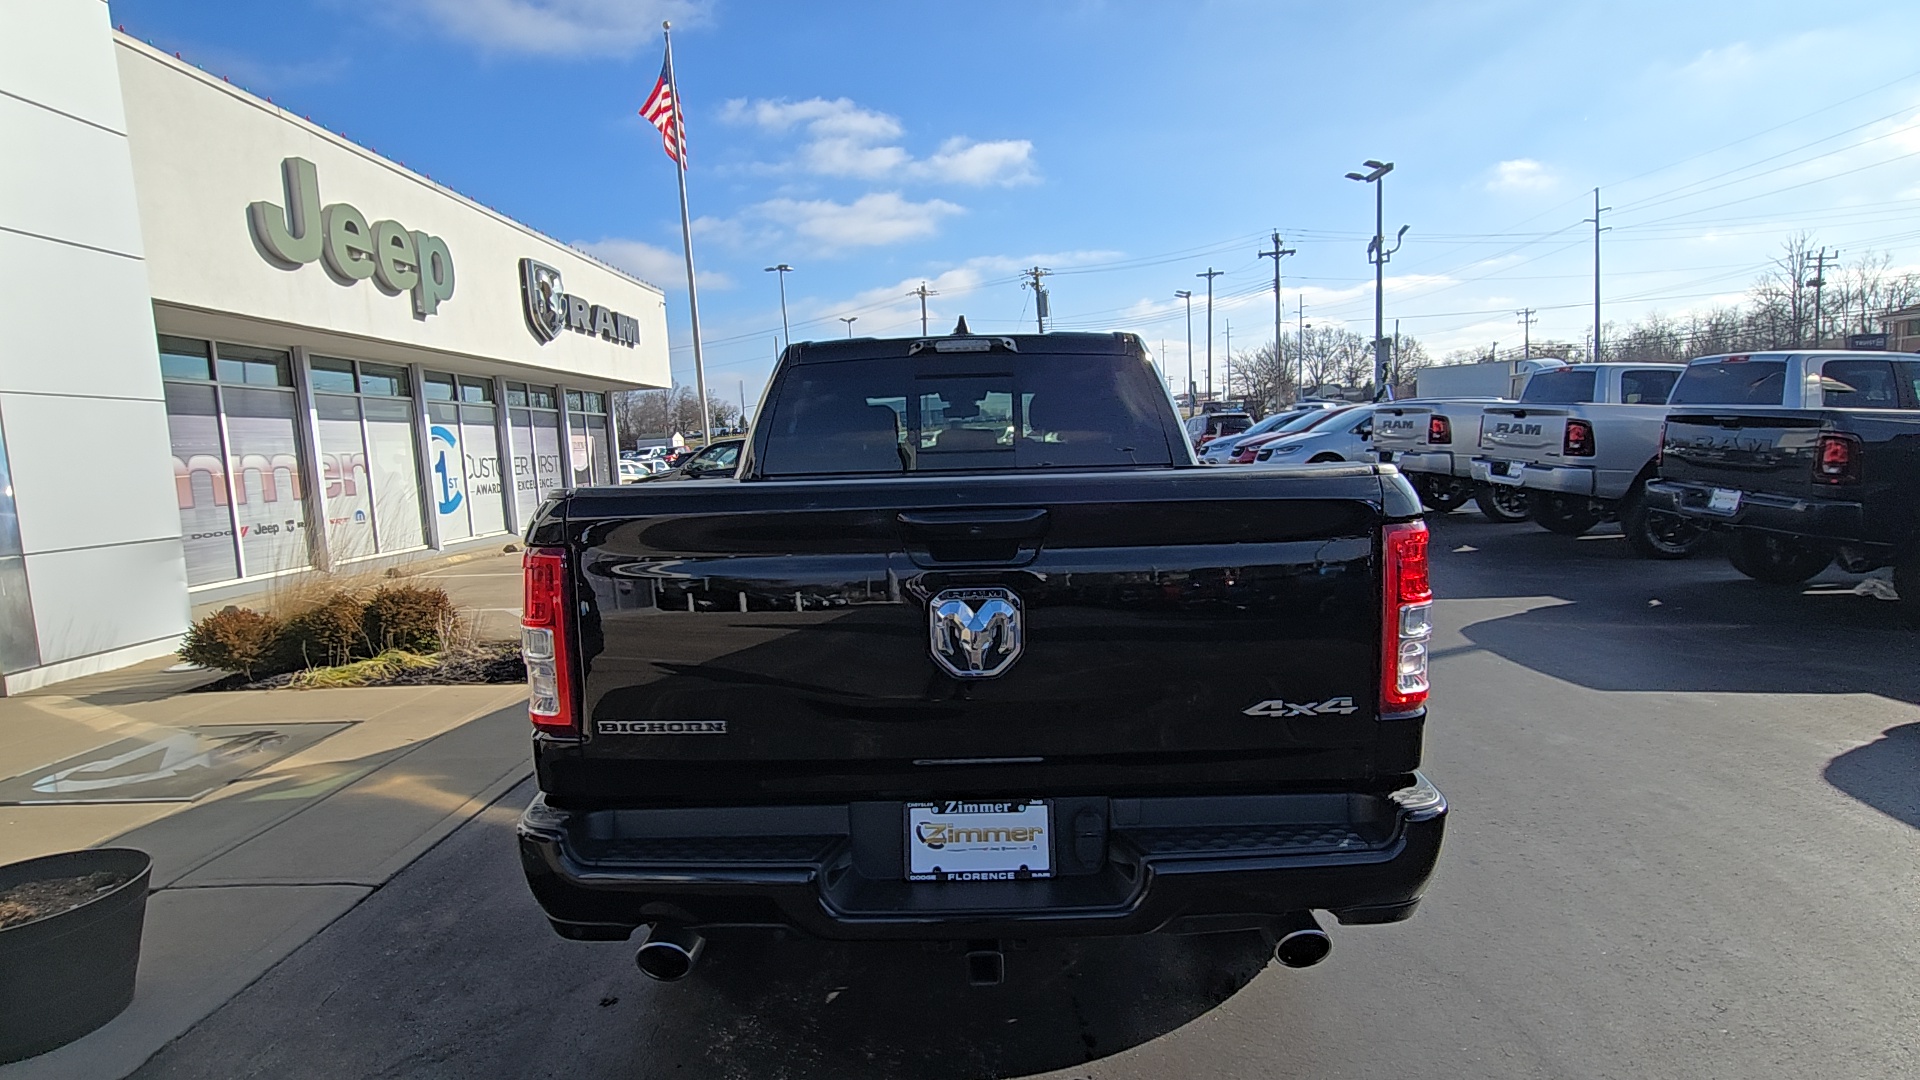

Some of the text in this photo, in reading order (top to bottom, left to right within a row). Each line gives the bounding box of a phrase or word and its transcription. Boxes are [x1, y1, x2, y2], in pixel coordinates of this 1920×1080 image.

[247, 156, 455, 321] Jeep
[563, 294, 640, 348] RAM
[1382, 420, 1414, 429] RAM
[1495, 422, 1542, 436] RAM
[1691, 435, 1773, 453] RAM
[253, 523, 280, 536] Jeep
[1241, 697, 1359, 718] 4x4
[598, 720, 727, 734] BIGHORN
[945, 801, 1011, 814] Zimmer
[924, 823, 1043, 844] Zimmer
[948, 872, 1015, 881] FLORENCE
